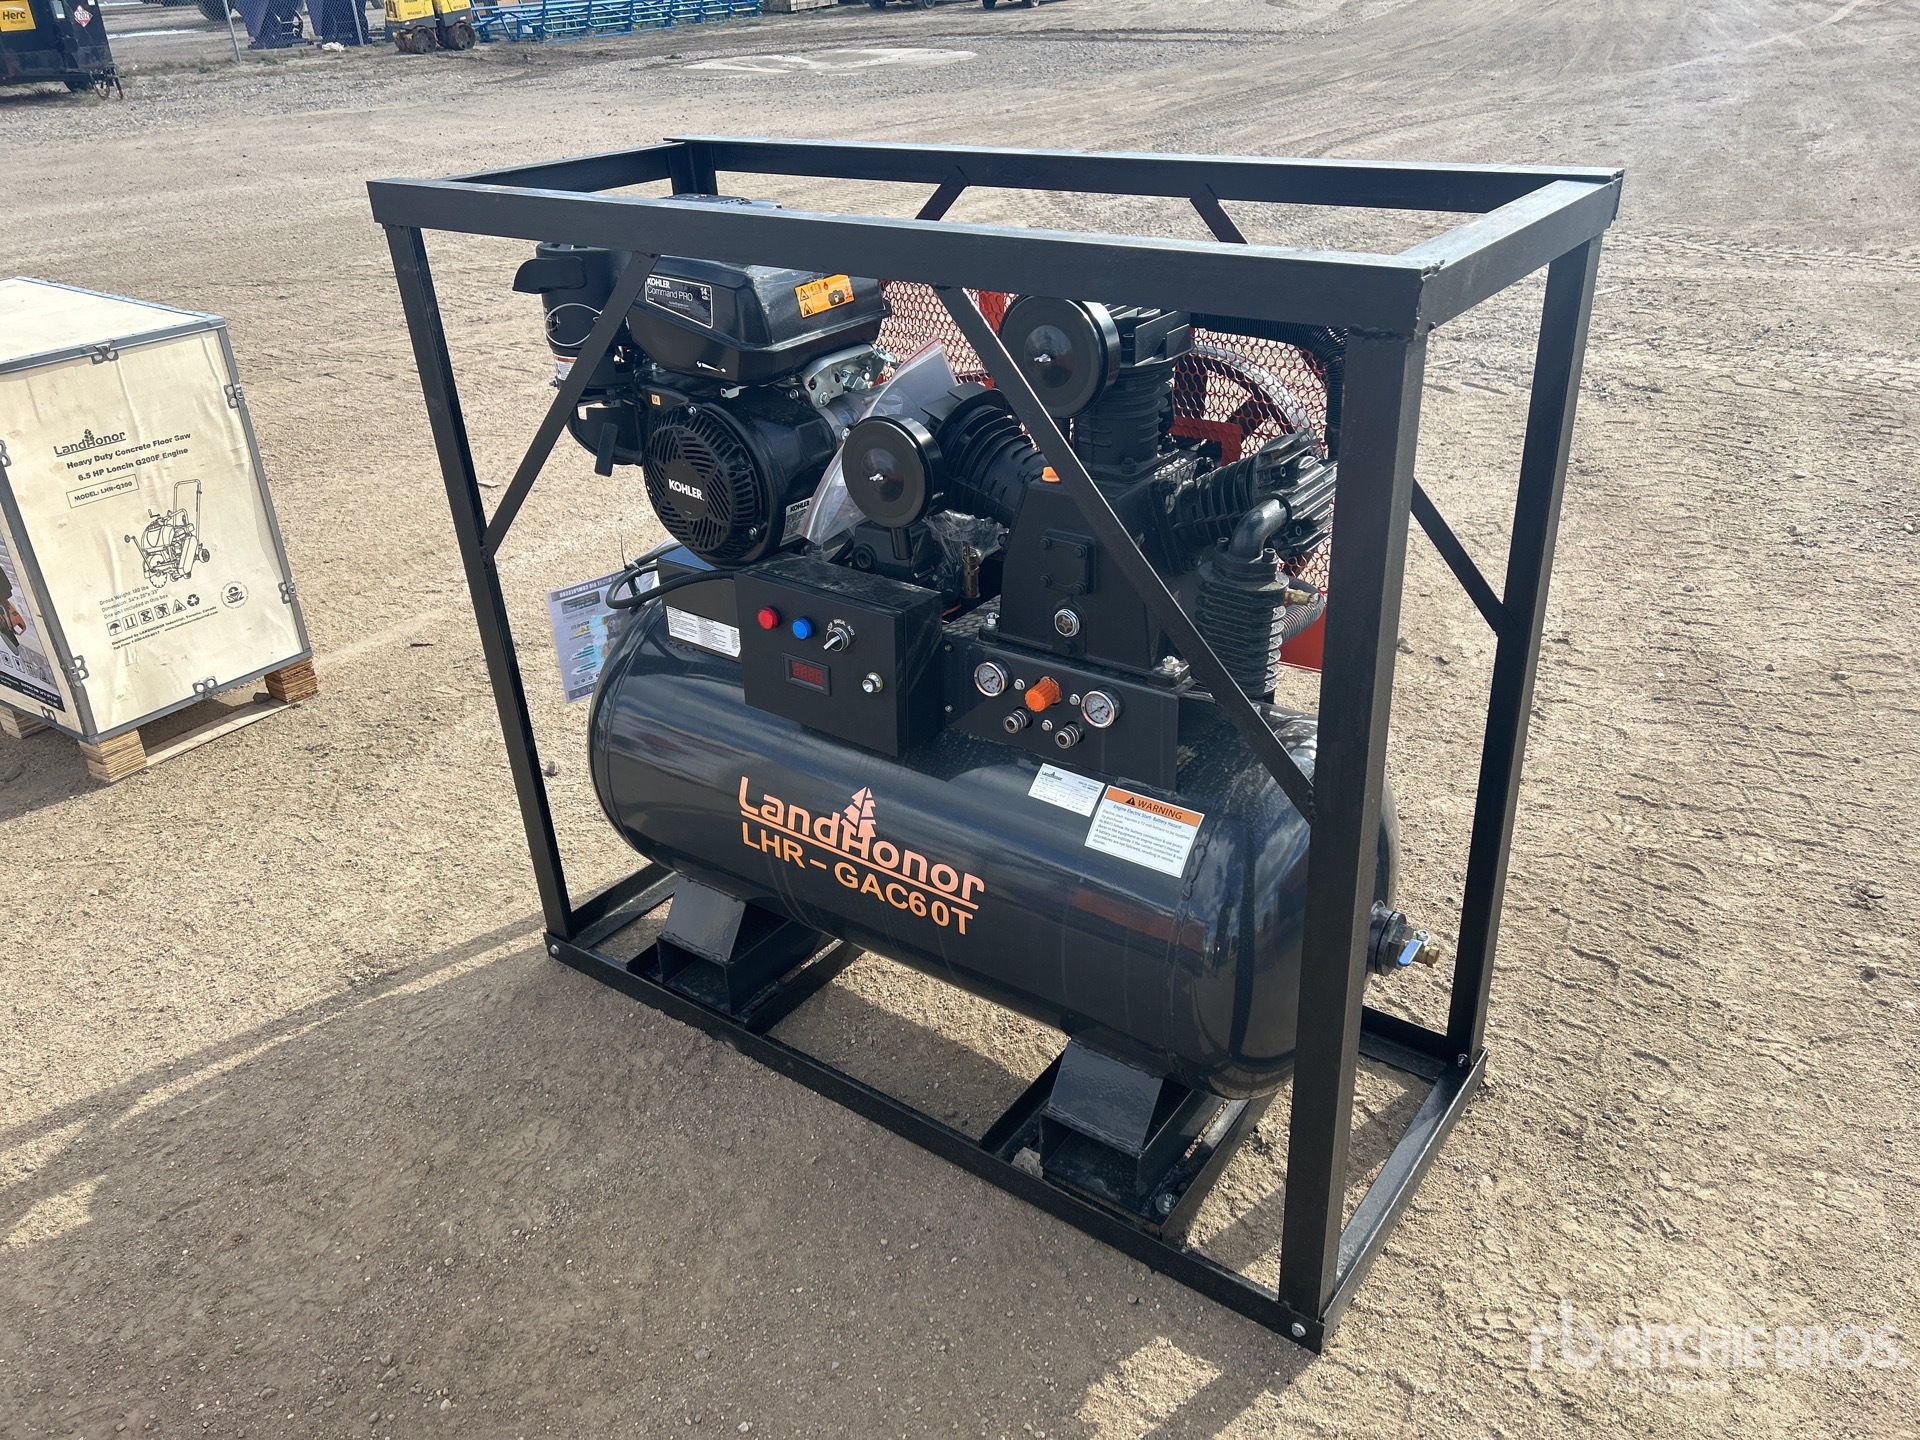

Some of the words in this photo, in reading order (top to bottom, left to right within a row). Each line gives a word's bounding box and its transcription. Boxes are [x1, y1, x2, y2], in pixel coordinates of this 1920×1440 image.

[2, 11, 26, 20] Herc
[647, 277, 671, 289] KOHLER
[700, 287, 708, 296] 14
[647, 285, 678, 299] Command
[678, 291, 694, 302] PRO
[53, 429, 126, 457] LandHonor
[66, 458, 92, 468] Heavy
[94, 453, 112, 461] Duty
[115, 443, 150, 456] Concrete
[152, 437, 172, 446] Floor
[174, 433, 190, 441] Saw
[78, 472, 91, 480] 6.5
[92, 468, 104, 476] HP
[106, 462, 133, 473] Loncin
[162, 448, 188, 458] Engine
[74, 491, 99, 500] MODEL:
[668, 478, 704, 501] KOHLER
[790, 500, 810, 512] KOHLER
[1127, 808, 1140, 816] Electric
[1152, 816, 1166, 825] Battery
[1138, 800, 1182, 819] WARNING
[738, 776, 985, 909] LandHonor
[742, 822, 806, 869] LHR
[834, 862, 974, 935] GAC60T
